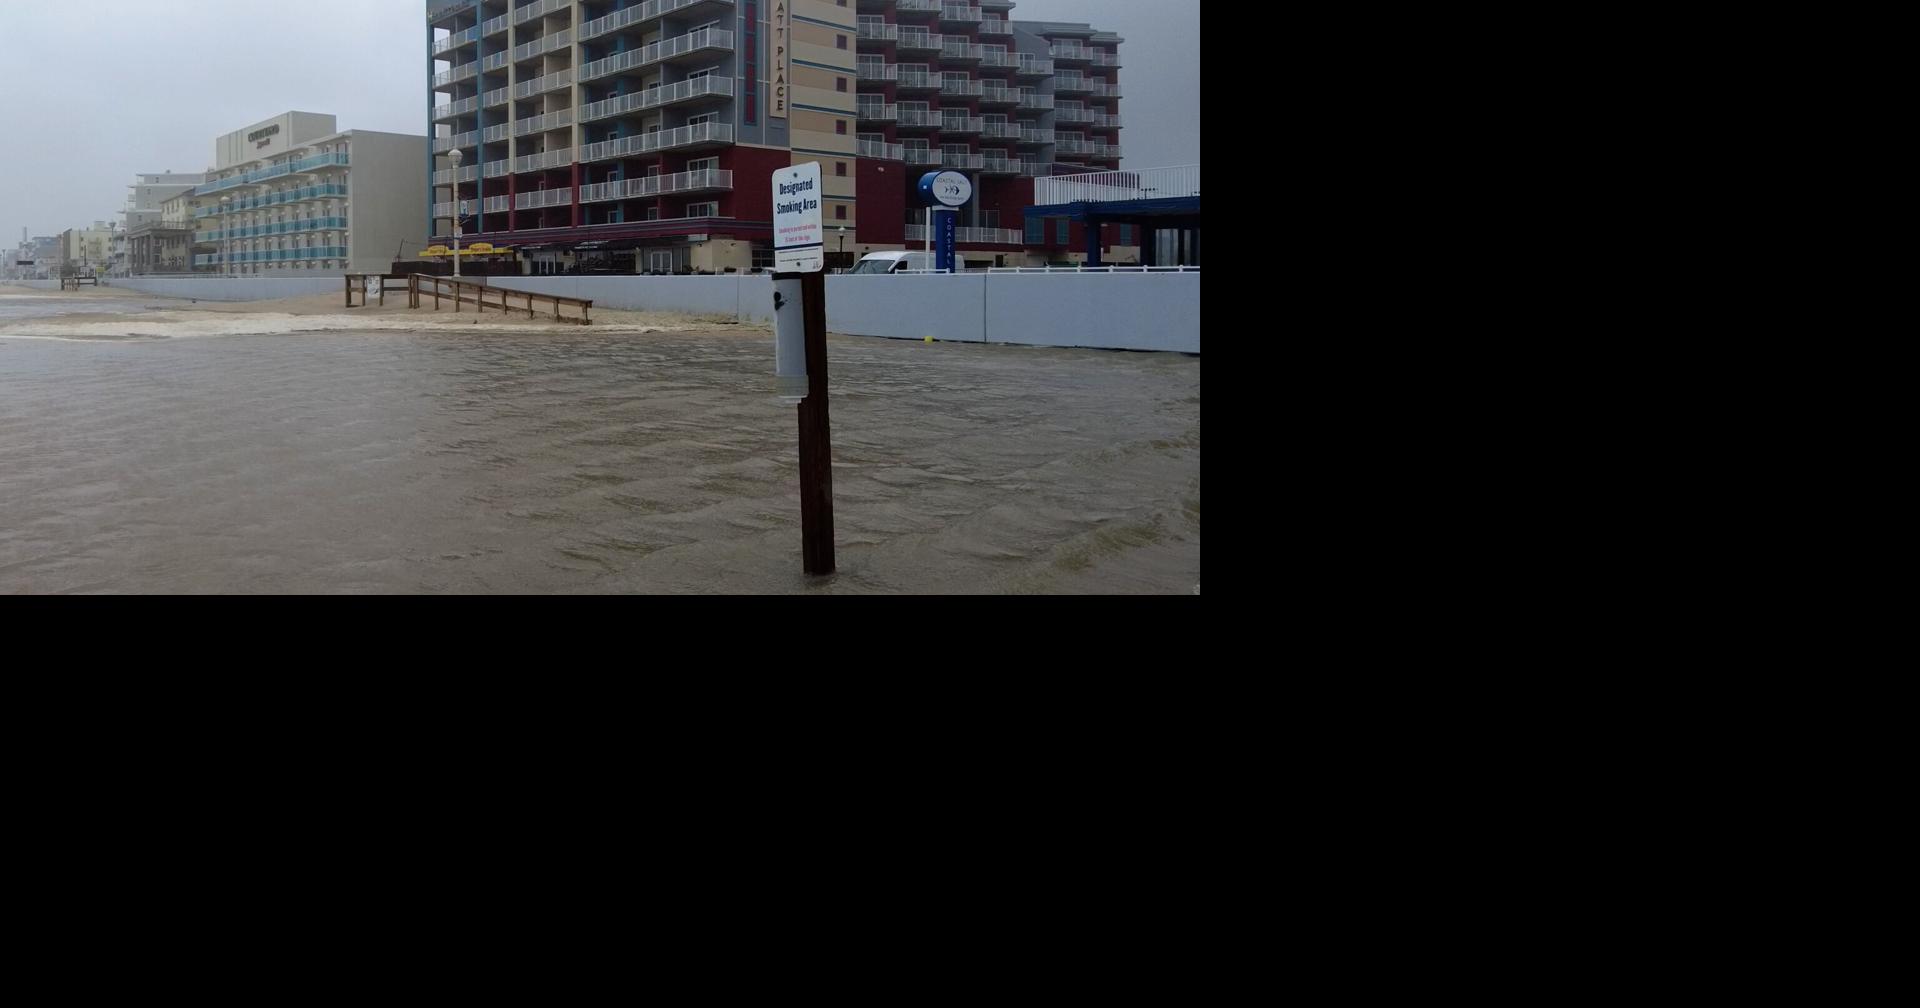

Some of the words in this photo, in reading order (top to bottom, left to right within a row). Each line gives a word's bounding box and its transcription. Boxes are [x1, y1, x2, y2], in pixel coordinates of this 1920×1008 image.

[776, 0, 784, 38] ATT
[776, 46, 784, 111] PLACE
[779, 177, 813, 196] Designated
[776, 200, 803, 215] Smoking
[803, 198, 818, 210] Area
